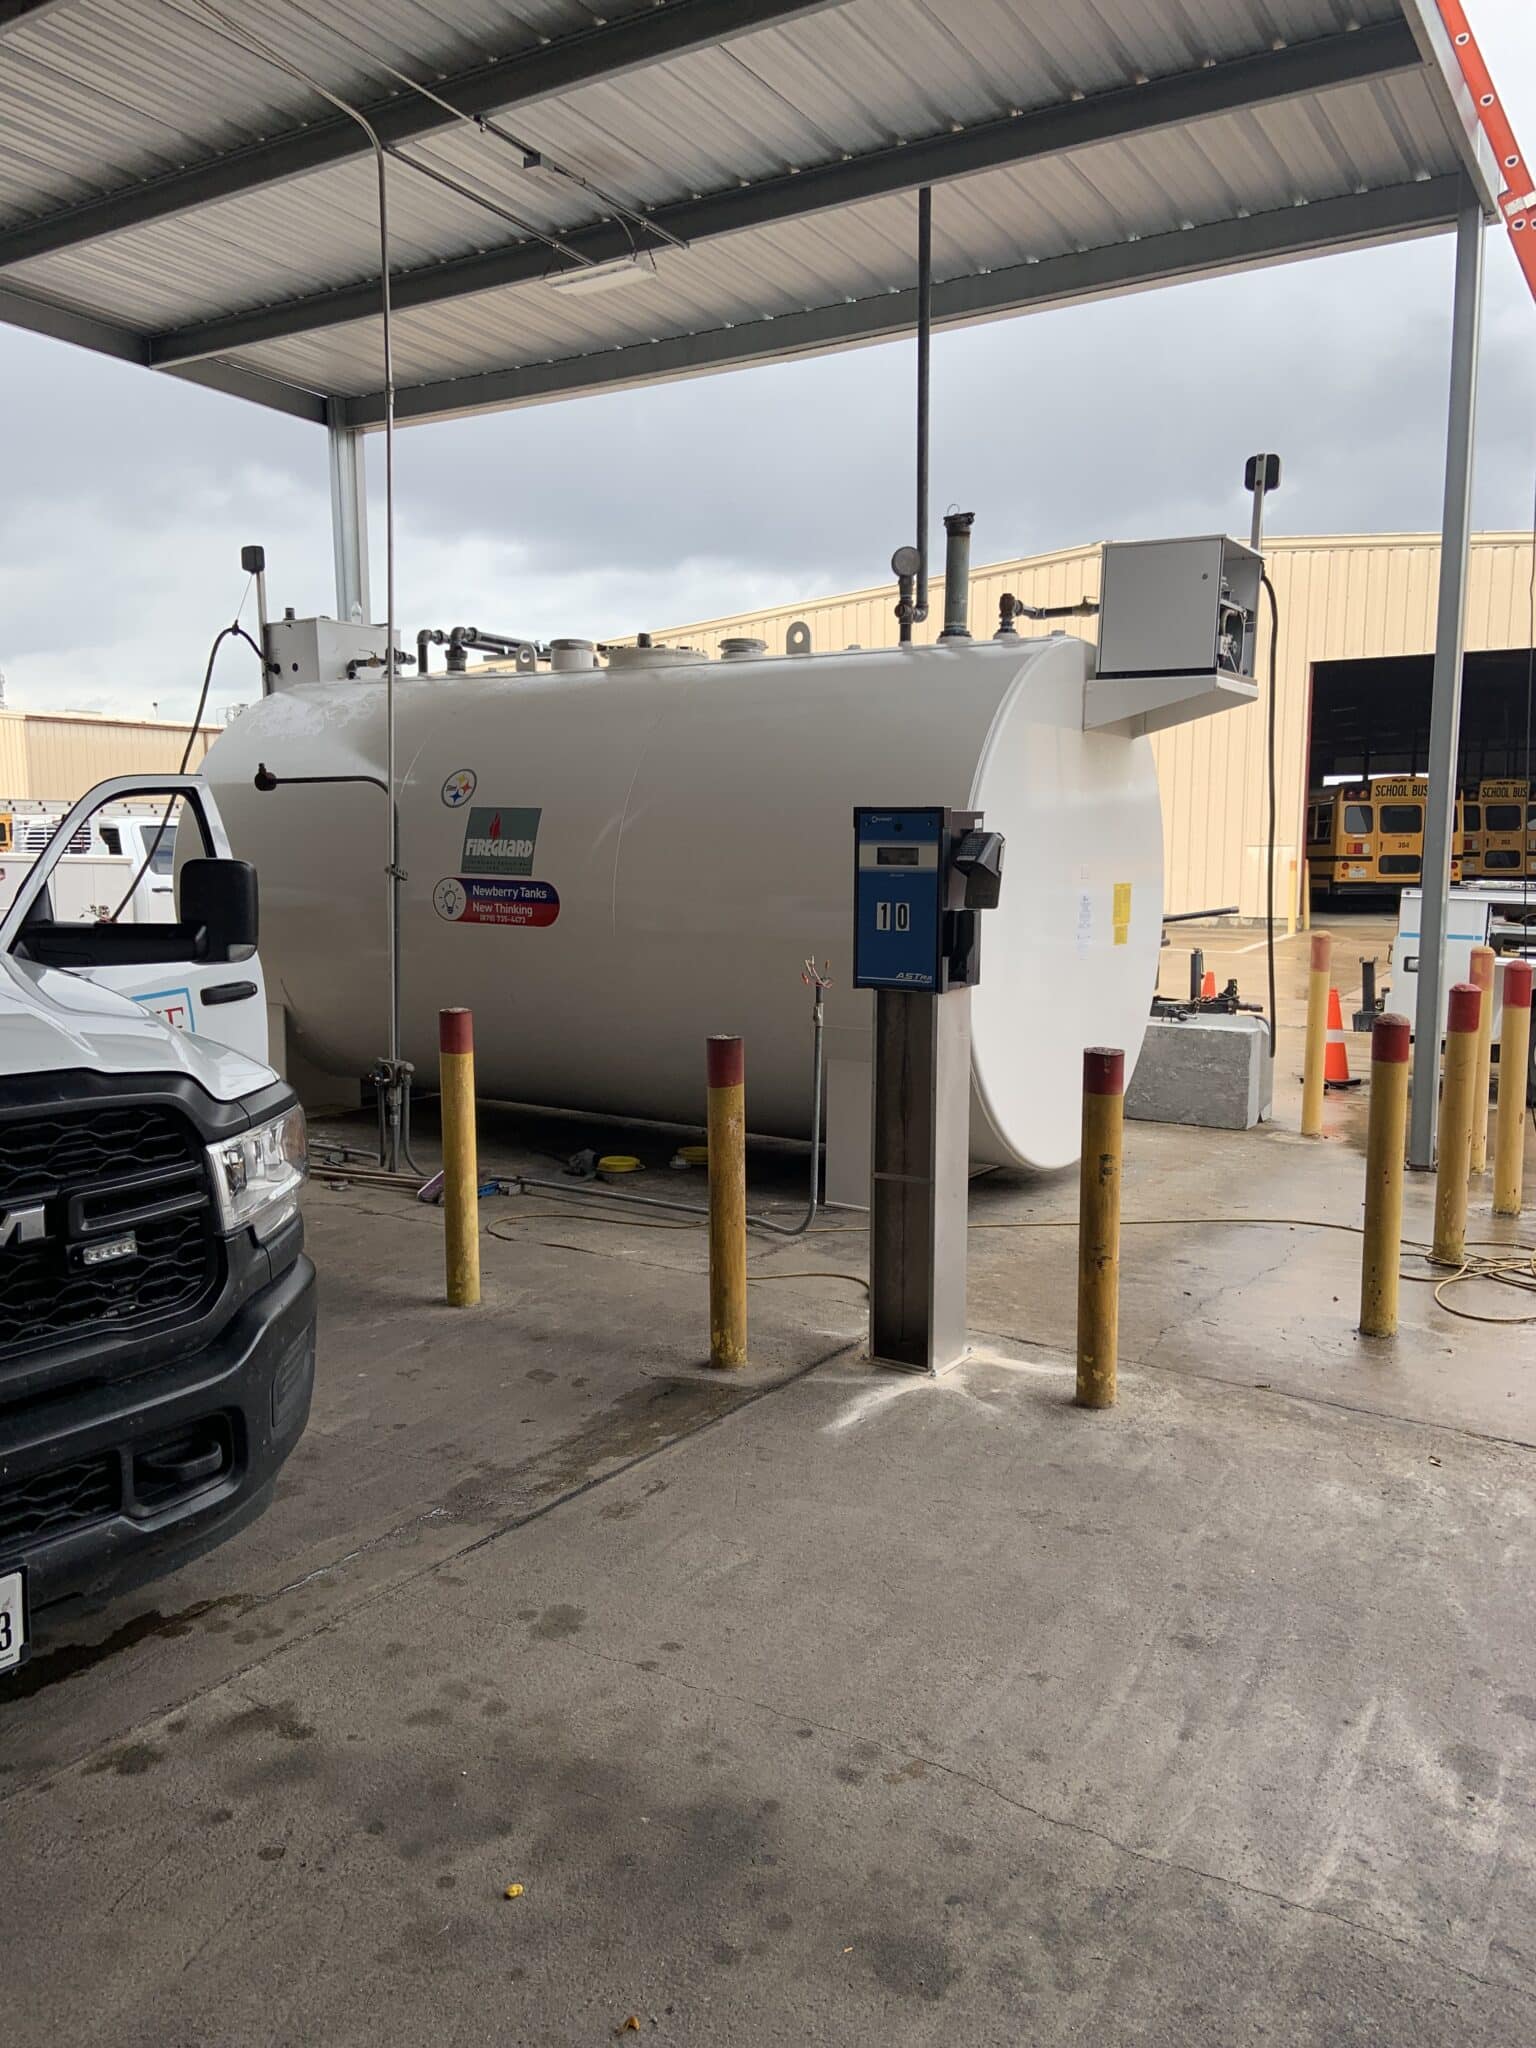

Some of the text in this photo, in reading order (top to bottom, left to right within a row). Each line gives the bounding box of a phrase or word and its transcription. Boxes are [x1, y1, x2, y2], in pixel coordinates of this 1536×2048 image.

[1375, 784, 1428, 797] SCHOOL BUS
[1481, 786, 1528, 798] SCHOOL BUS
[472, 885, 547, 900] Newberry Tanks
[472, 901, 533, 918] New Thinking
[880, 903, 909, 930] 10
